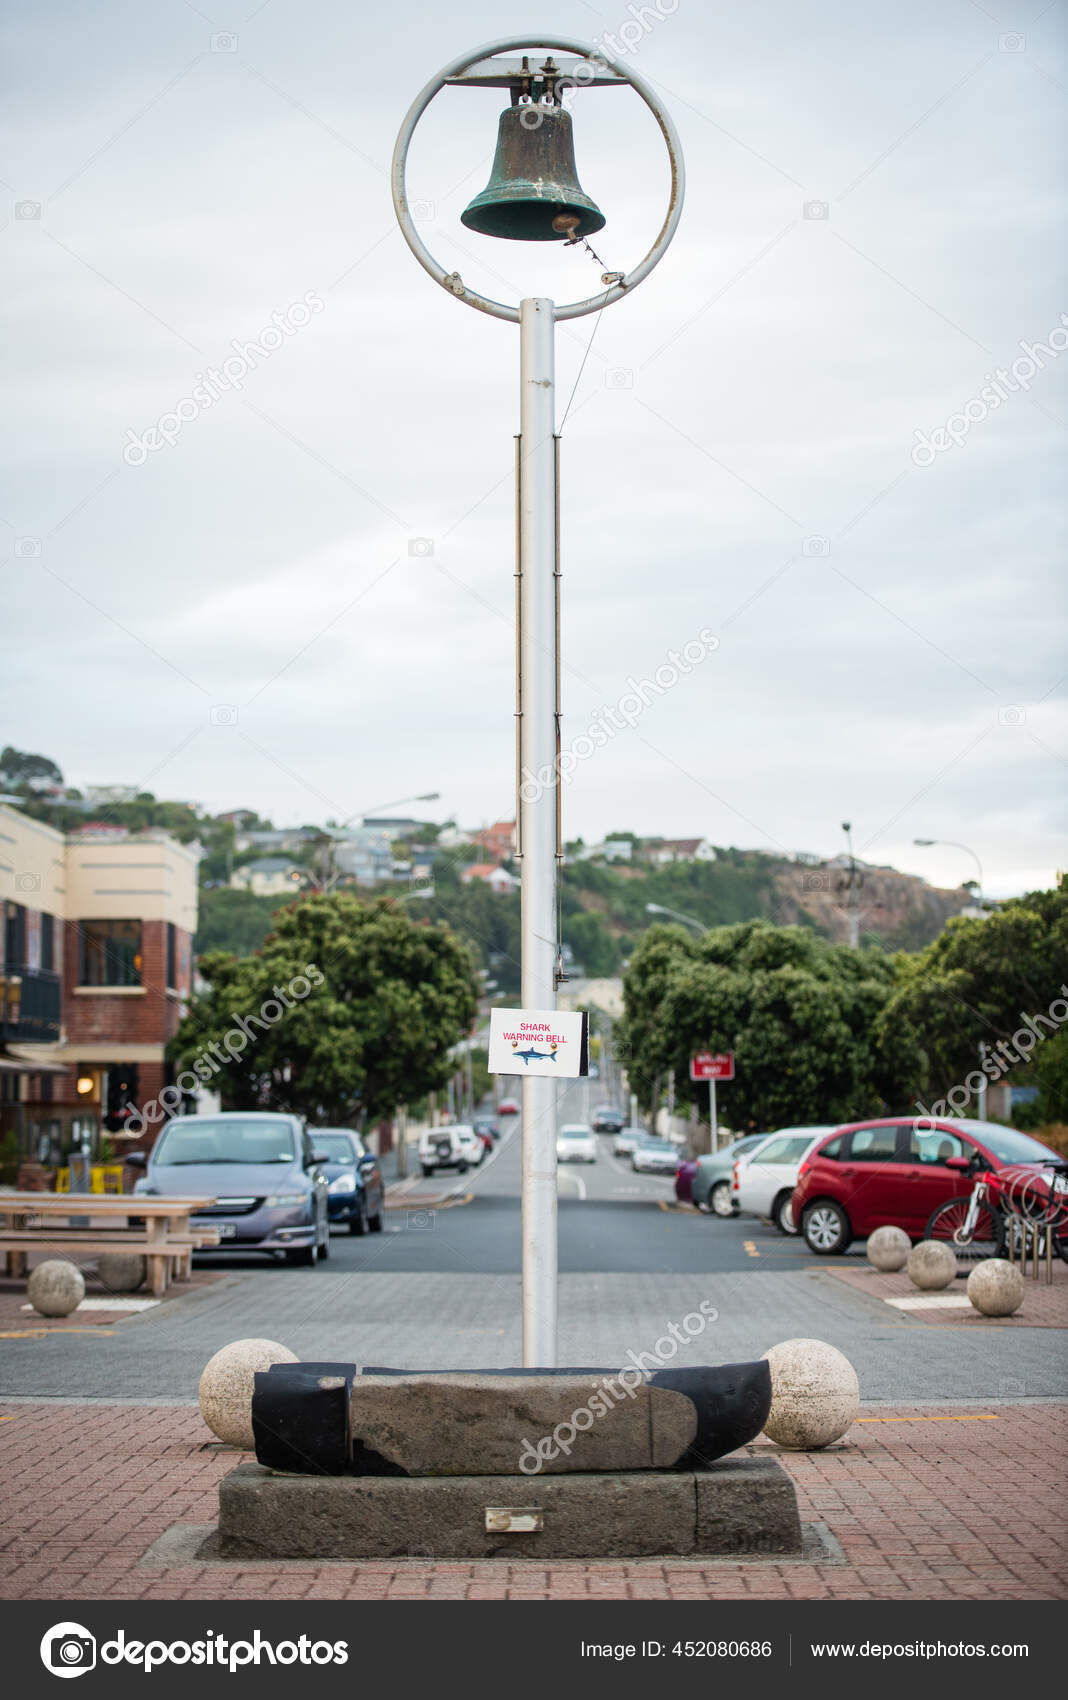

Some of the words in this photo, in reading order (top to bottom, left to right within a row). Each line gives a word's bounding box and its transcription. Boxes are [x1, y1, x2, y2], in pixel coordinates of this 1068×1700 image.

[520, 1022, 551, 1032] SHARK
[503, 1032, 544, 1042] WARNING
[545, 1034, 568, 1044] BELL
